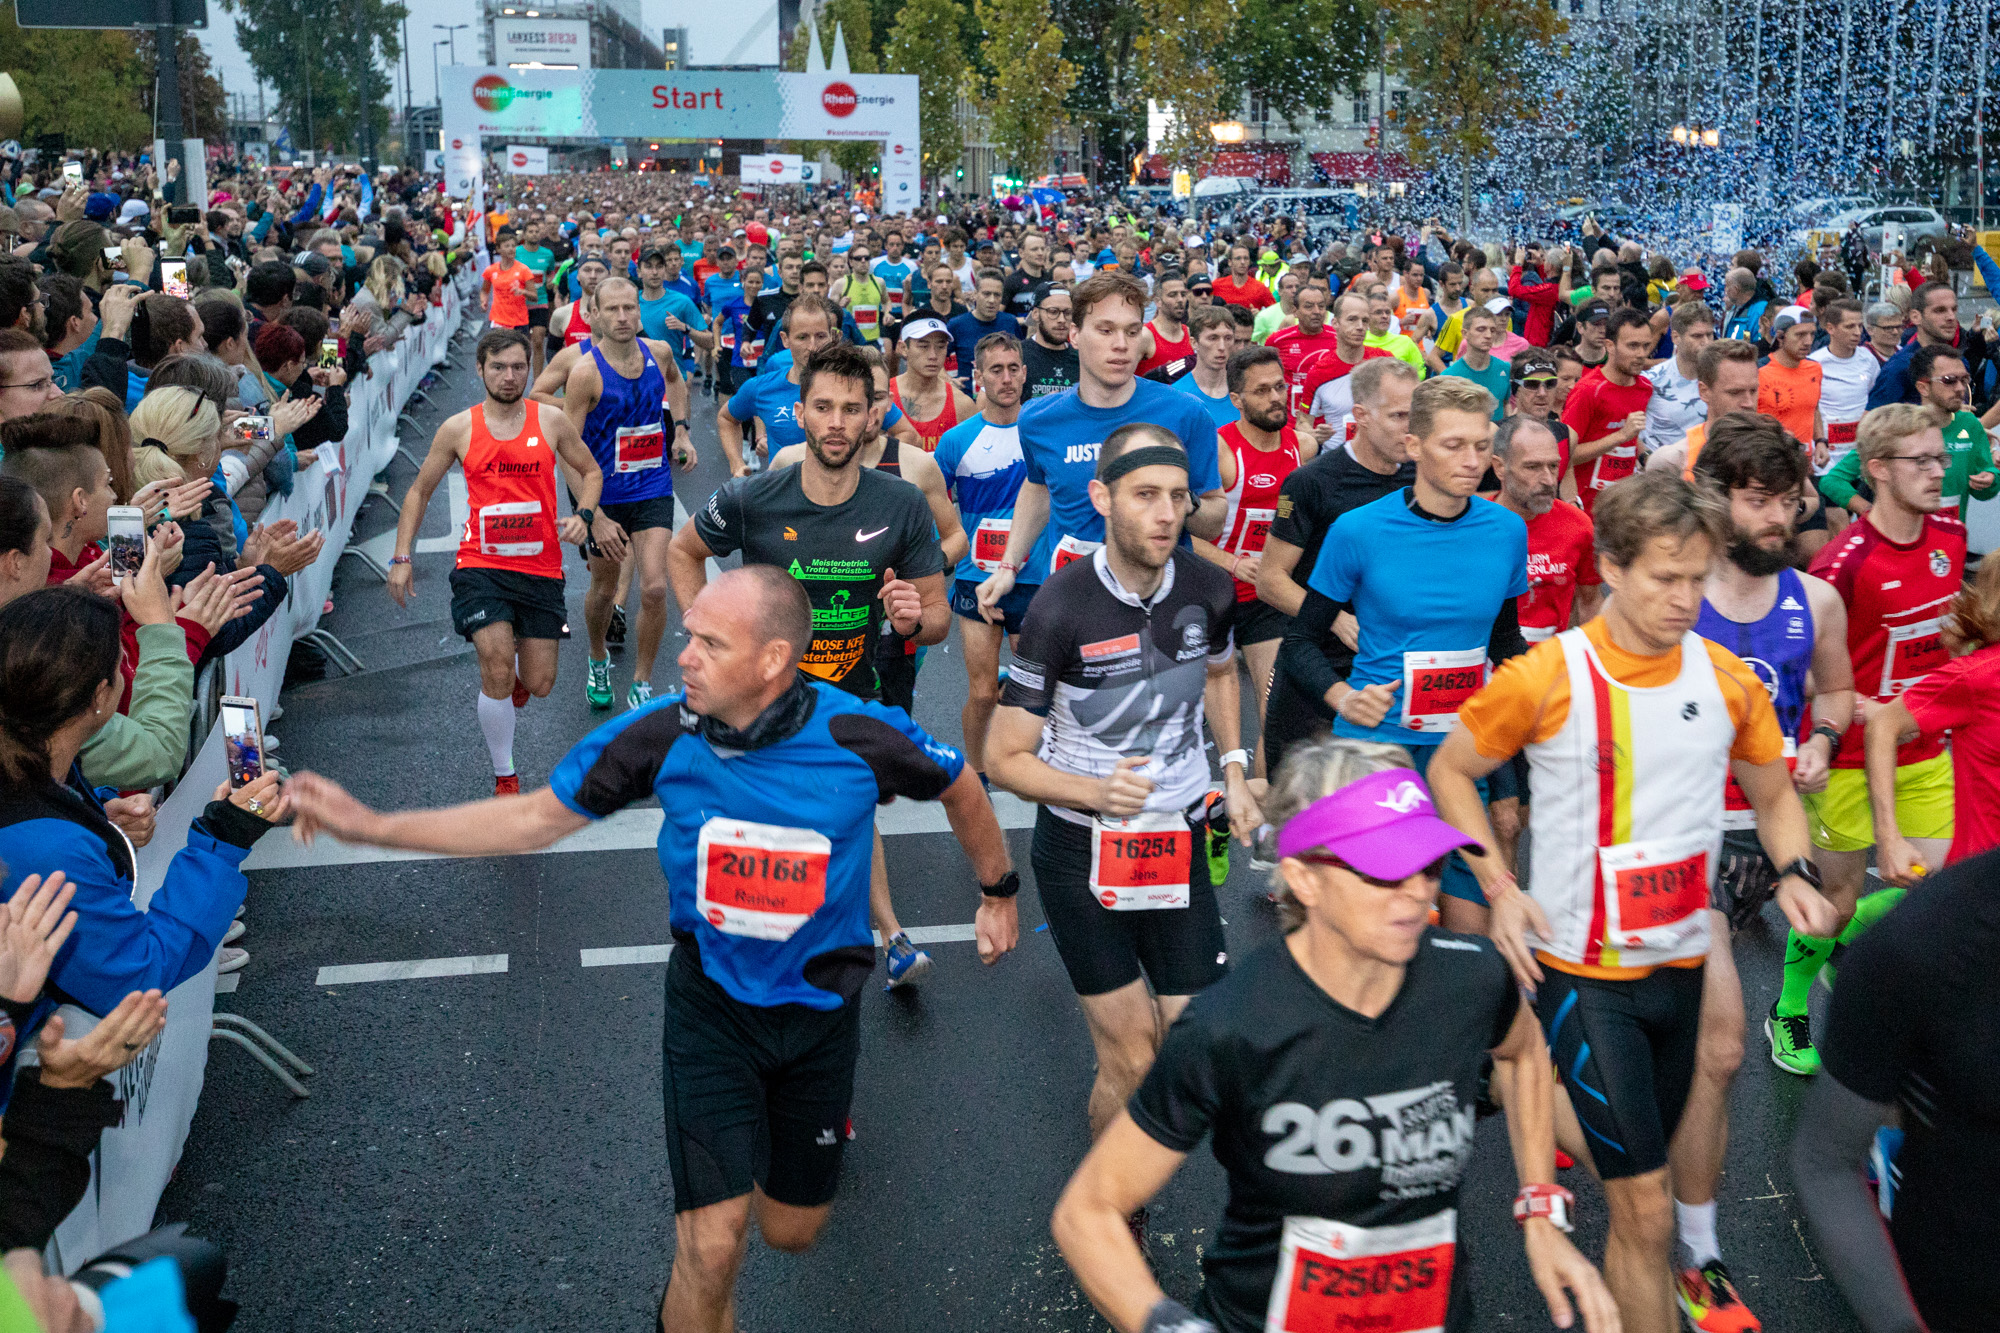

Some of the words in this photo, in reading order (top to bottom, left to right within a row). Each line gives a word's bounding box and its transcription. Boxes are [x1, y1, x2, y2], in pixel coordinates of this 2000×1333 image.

[652, 85, 724, 110] Start
[824, 93, 895, 106] RheinEnergie
[1064, 442, 1102, 464] JUST
[499, 461, 540, 472] bunert
[492, 516, 534, 529] 24222
[806, 565, 829, 574] Trotta
[811, 559, 869, 567] Meisterbetrieb
[811, 640, 845, 651] ROSE
[1421, 671, 1477, 692] 24620
[1112, 837, 1176, 859] 16254
[721, 851, 808, 883] 20168
[1129, 869, 1158, 881] Jens
[1300, 1258, 1437, 1298] F25035
